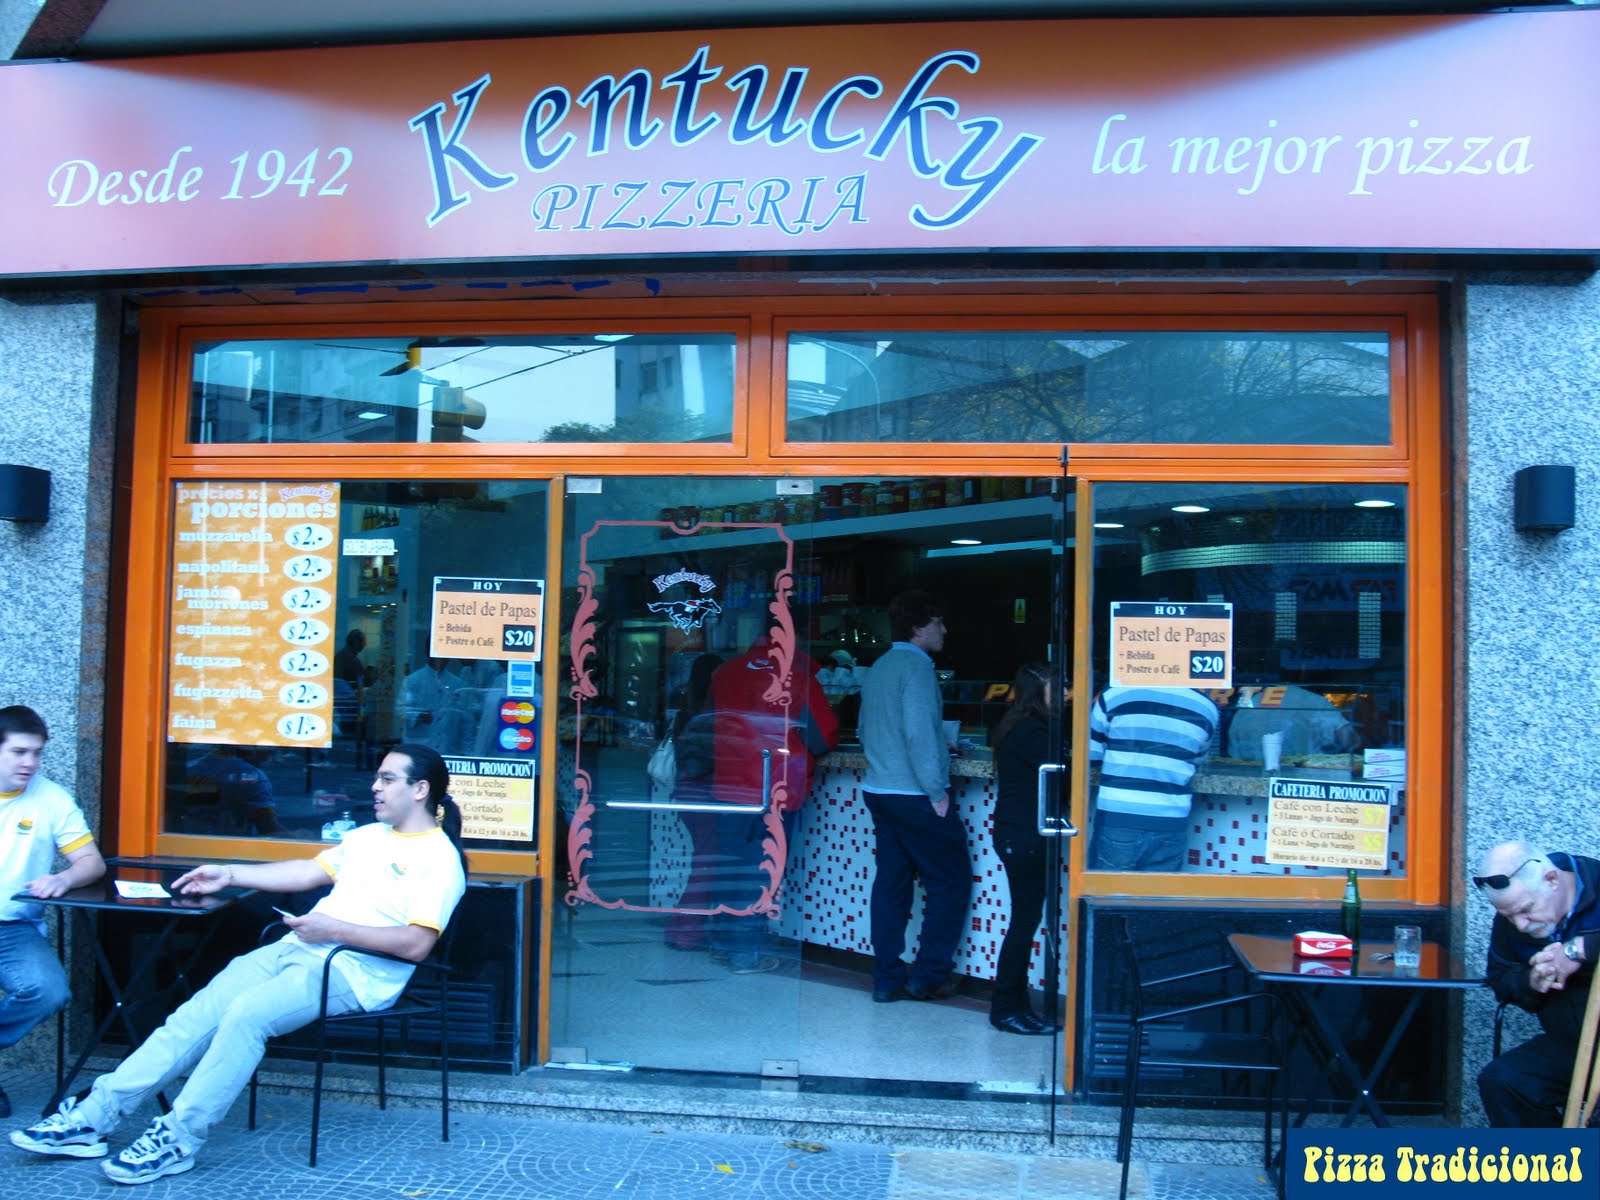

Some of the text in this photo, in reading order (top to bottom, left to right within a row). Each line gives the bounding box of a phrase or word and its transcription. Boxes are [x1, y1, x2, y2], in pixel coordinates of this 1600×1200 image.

[408, 46, 1045, 231] Kentucky
[1091, 113, 1535, 195] la mejor pizza
[48, 146, 353, 207] Desde 1942
[531, 170, 870, 235] PIZZERIA
[177, 486, 244, 503] precios
[191, 496, 337, 524] porciones
[473, 581, 503, 591] HOY
[652, 567, 716, 593] Kentucky
[440, 600, 537, 621] Pastel de Papas
[1154, 606, 1188, 615] HOY
[504, 629, 534, 646] $20
[1119, 626, 1226, 647] Pastel de Papas
[1126, 651, 1155, 660] Bebida
[1126, 664, 1152, 674] Postre
[1192, 656, 1224, 673] $20
[479, 762, 532, 777] PROMOCION
[455, 779, 473, 787] con
[476, 778, 506, 788] Leche
[1273, 783, 1388, 802] CAFETERIA PROMOCION
[463, 803, 503, 813] Cortado
[1274, 801, 1300, 811] Café
[1302, 804, 1322, 812] con
[1325, 804, 1359, 814] Leche
[1272, 827, 1298, 837] Café
[1311, 829, 1355, 841] Cortado
